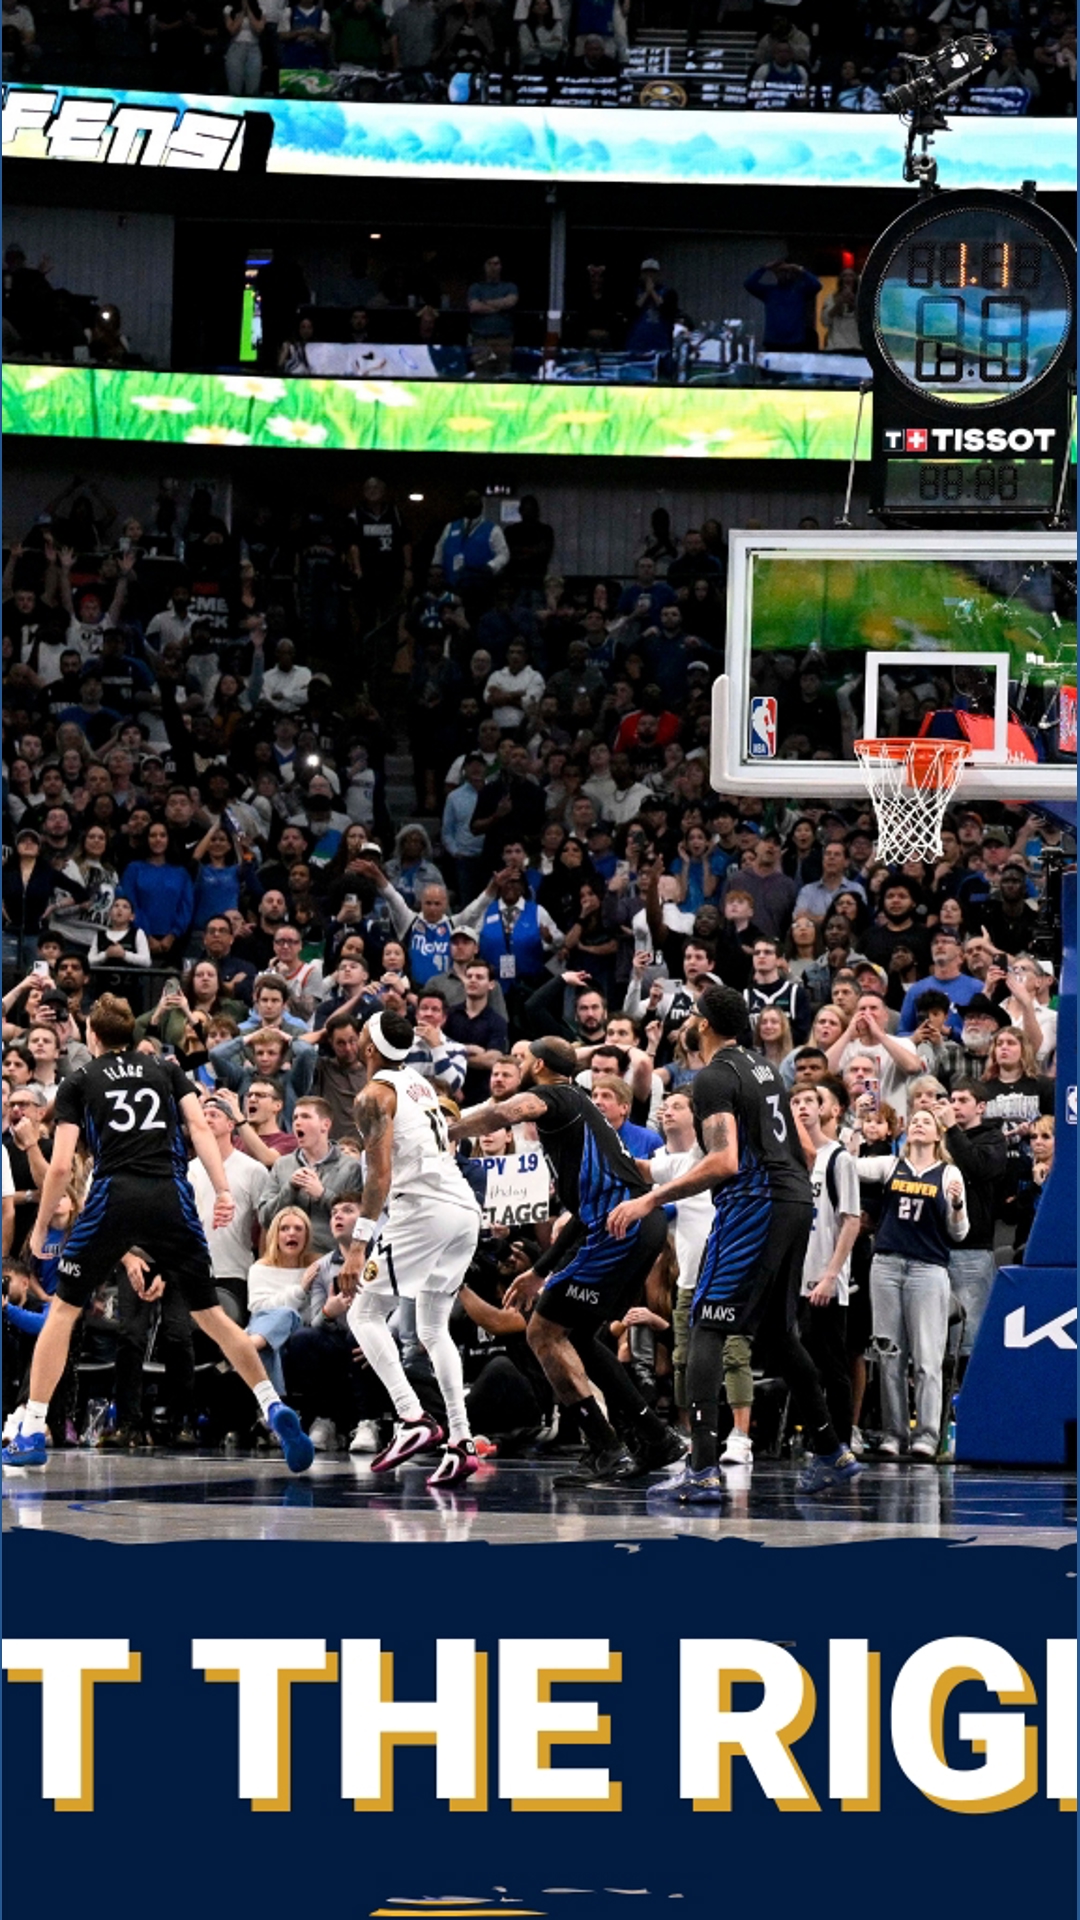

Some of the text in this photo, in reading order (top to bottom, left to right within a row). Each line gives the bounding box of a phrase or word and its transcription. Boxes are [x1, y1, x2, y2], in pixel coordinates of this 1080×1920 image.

[2, 89, 245, 171] FENS
[960, 242, 1009, 288] 1.1
[931, 428, 1056, 452] TISSOT
[104, 1088, 167, 1132] 32
[765, 1094, 788, 1143] 3
[517, 1153, 538, 1173] 19
[890, 1178, 939, 1199] DENVER
[897, 1196, 925, 1223] 27
[565, 1283, 601, 1305] MAVS
[700, 1304, 736, 1322] MAVS
